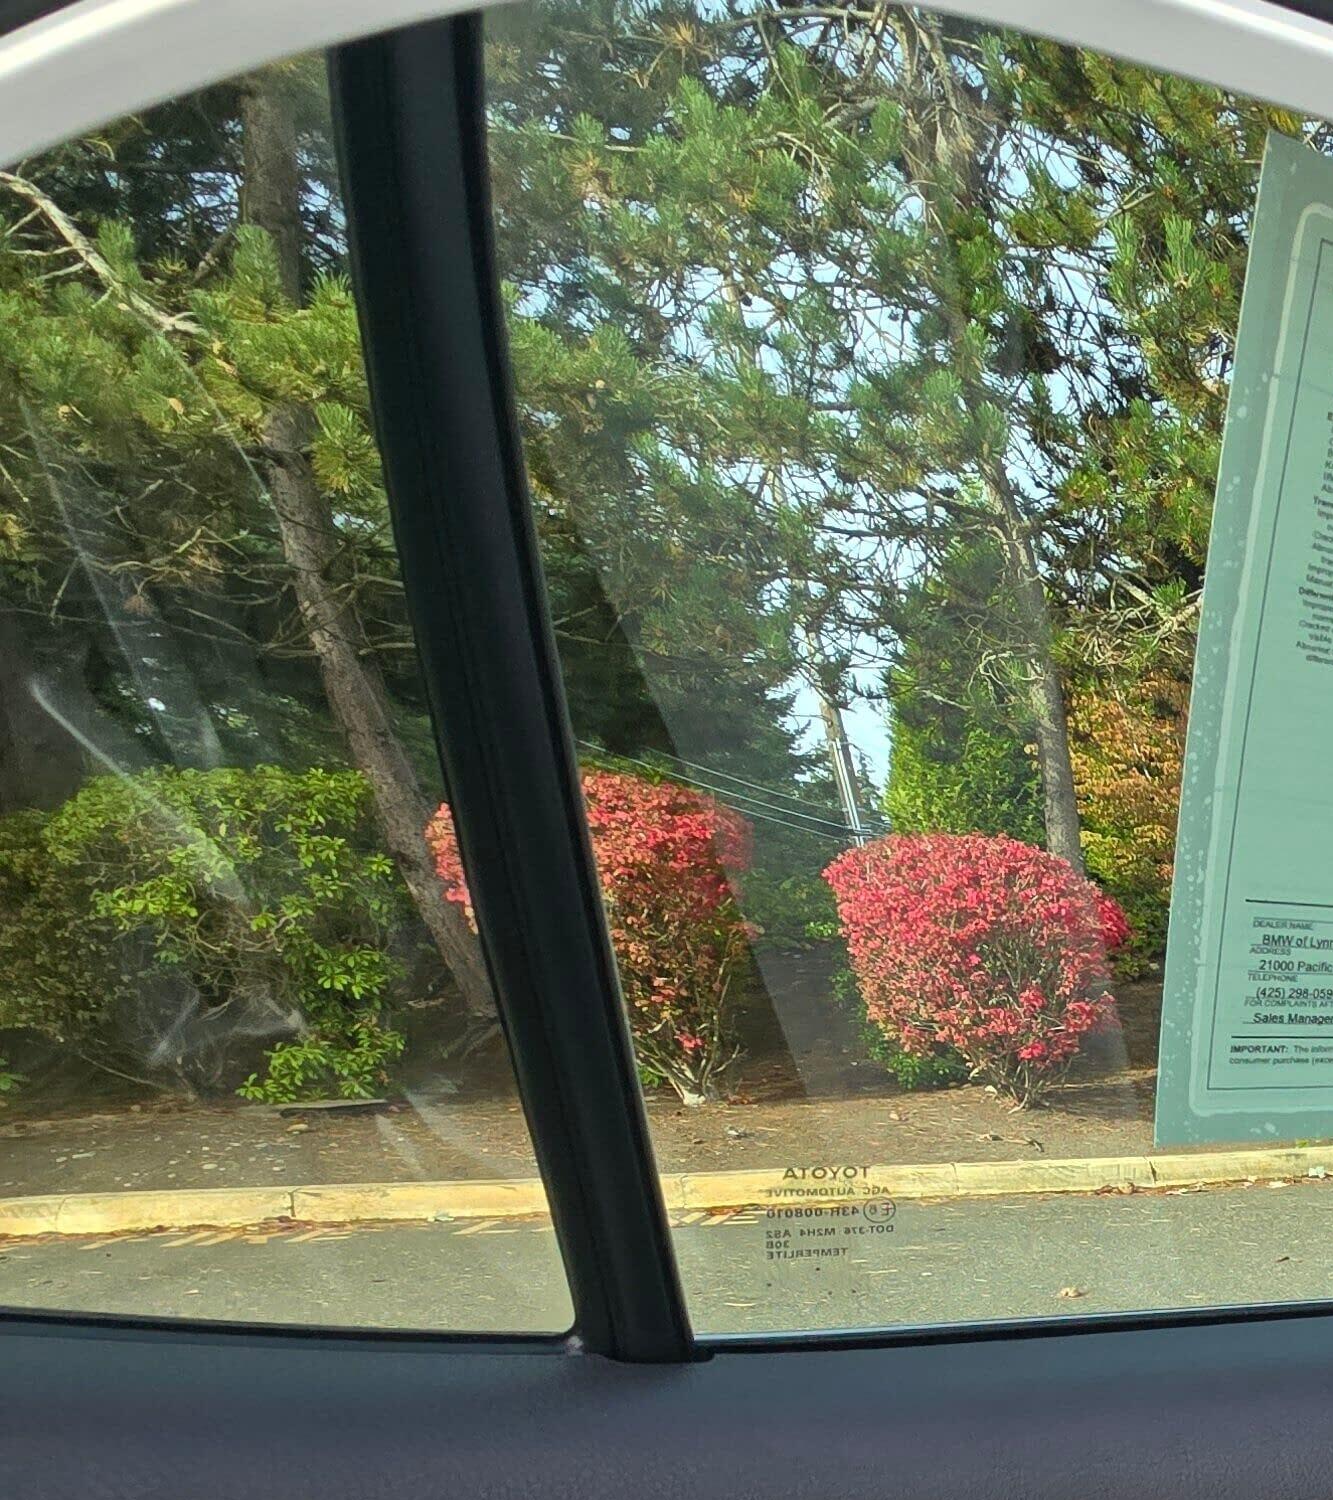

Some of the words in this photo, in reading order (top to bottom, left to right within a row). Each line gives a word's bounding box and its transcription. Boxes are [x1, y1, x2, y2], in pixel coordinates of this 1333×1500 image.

[1253, 920, 1287, 929] DEALER
[1290, 922, 1313, 930] NAME
[1262, 935, 1293, 946] BMW
[1296, 936, 1309, 948] of
[1259, 960, 1294, 971] 21000
[1298, 961, 1332, 973] Pacific
[1248, 974, 1298, 982] TELEPHONE
[1256, 988, 1286, 1000] (425)
[1253, 1013, 1284, 1023] Sales
[1229, 1045, 1289, 1053] IMPORTANT:
